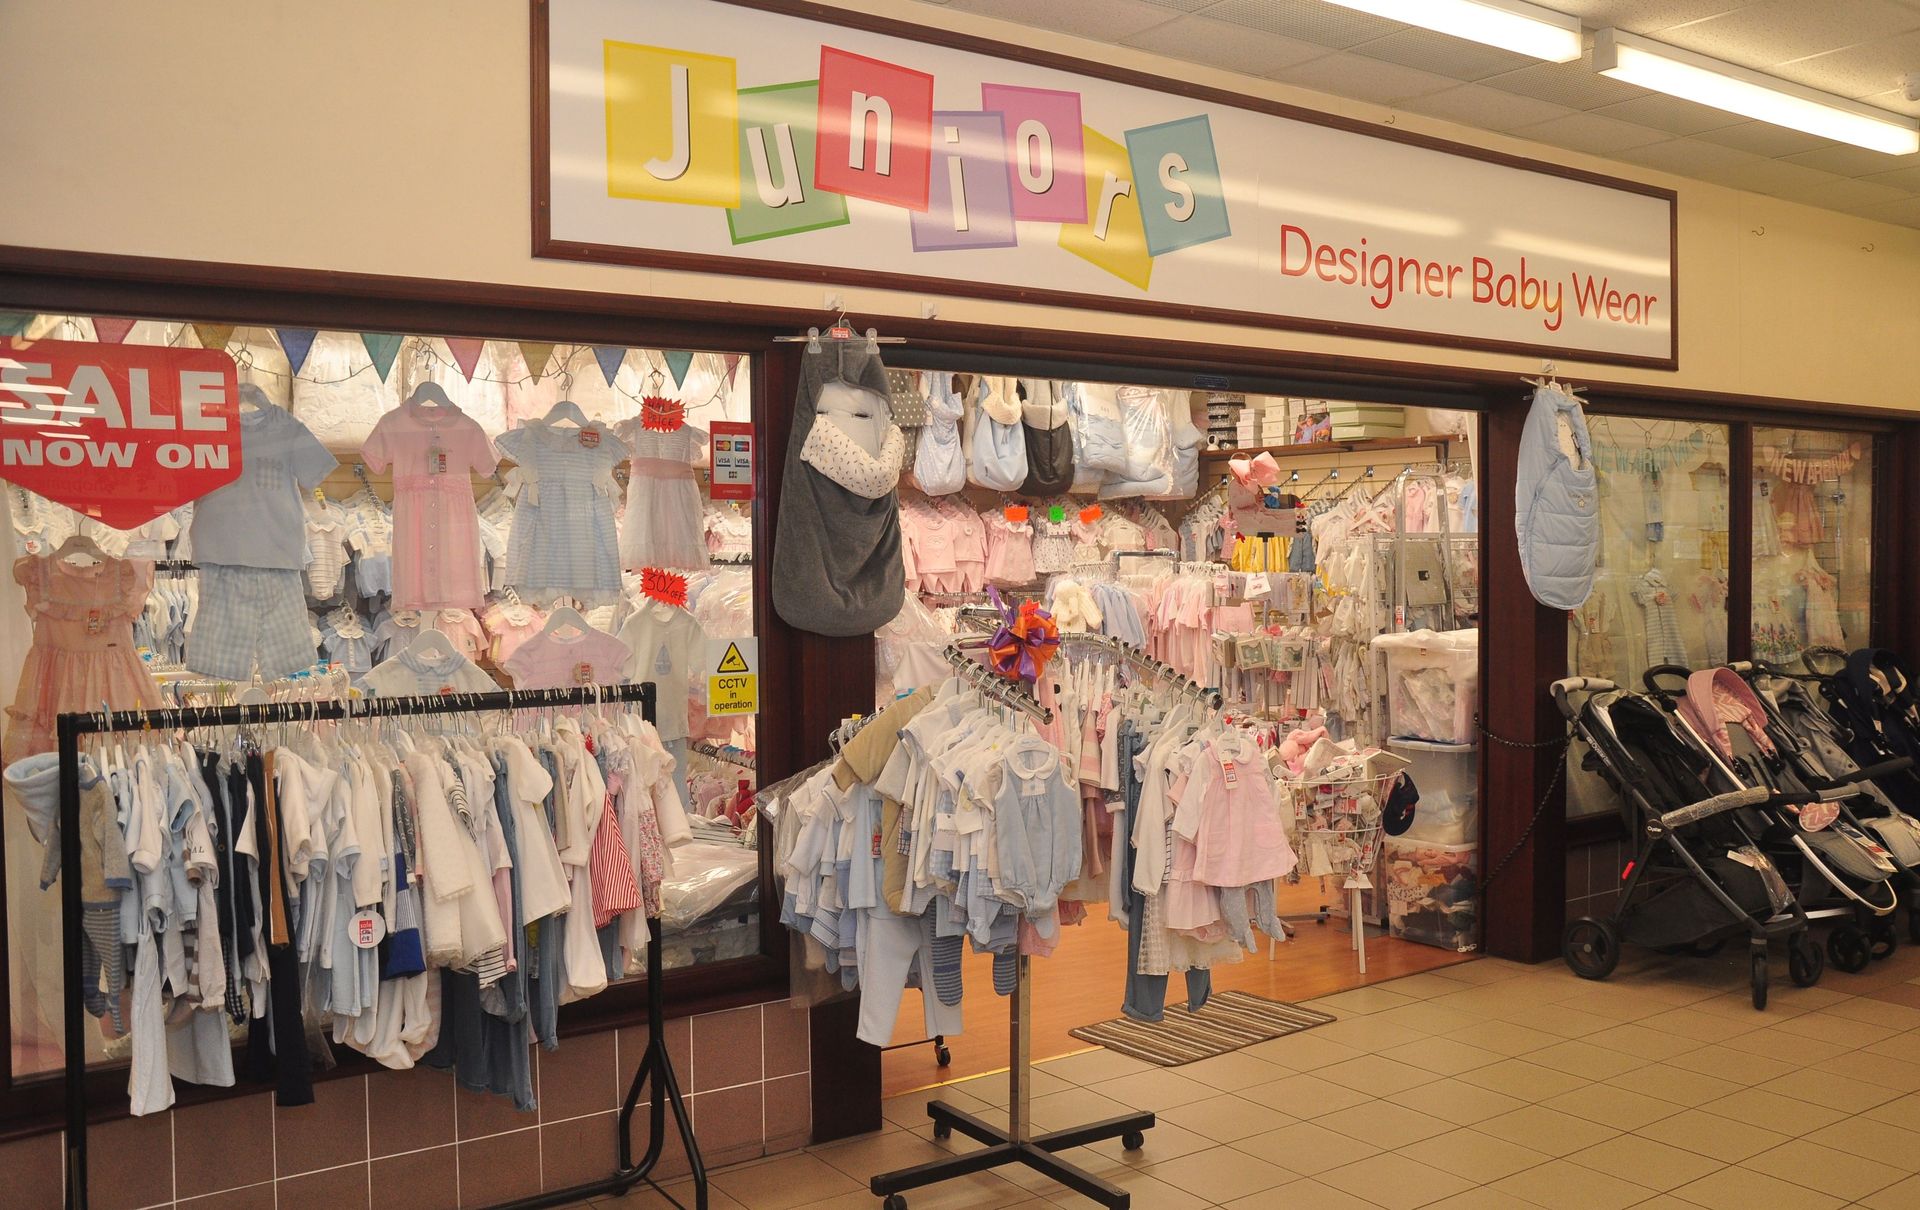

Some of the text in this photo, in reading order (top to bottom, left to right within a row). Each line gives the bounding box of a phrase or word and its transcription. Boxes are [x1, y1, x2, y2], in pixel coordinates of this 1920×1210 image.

[643, 63, 1197, 242] Juniors
[1280, 224, 1657, 331] Designer Baby Wear
[1, 361, 228, 431] SALE
[3, 439, 138, 468] NOW
[155, 443, 230, 469] ON
[718, 456, 731, 464] VISA
[1770, 450, 1806, 484] NEW
[645, 572, 675, 594] 30%
[718, 678, 747, 689] CCTV
[729, 690, 736, 699] in
[714, 699, 752, 711] operation
